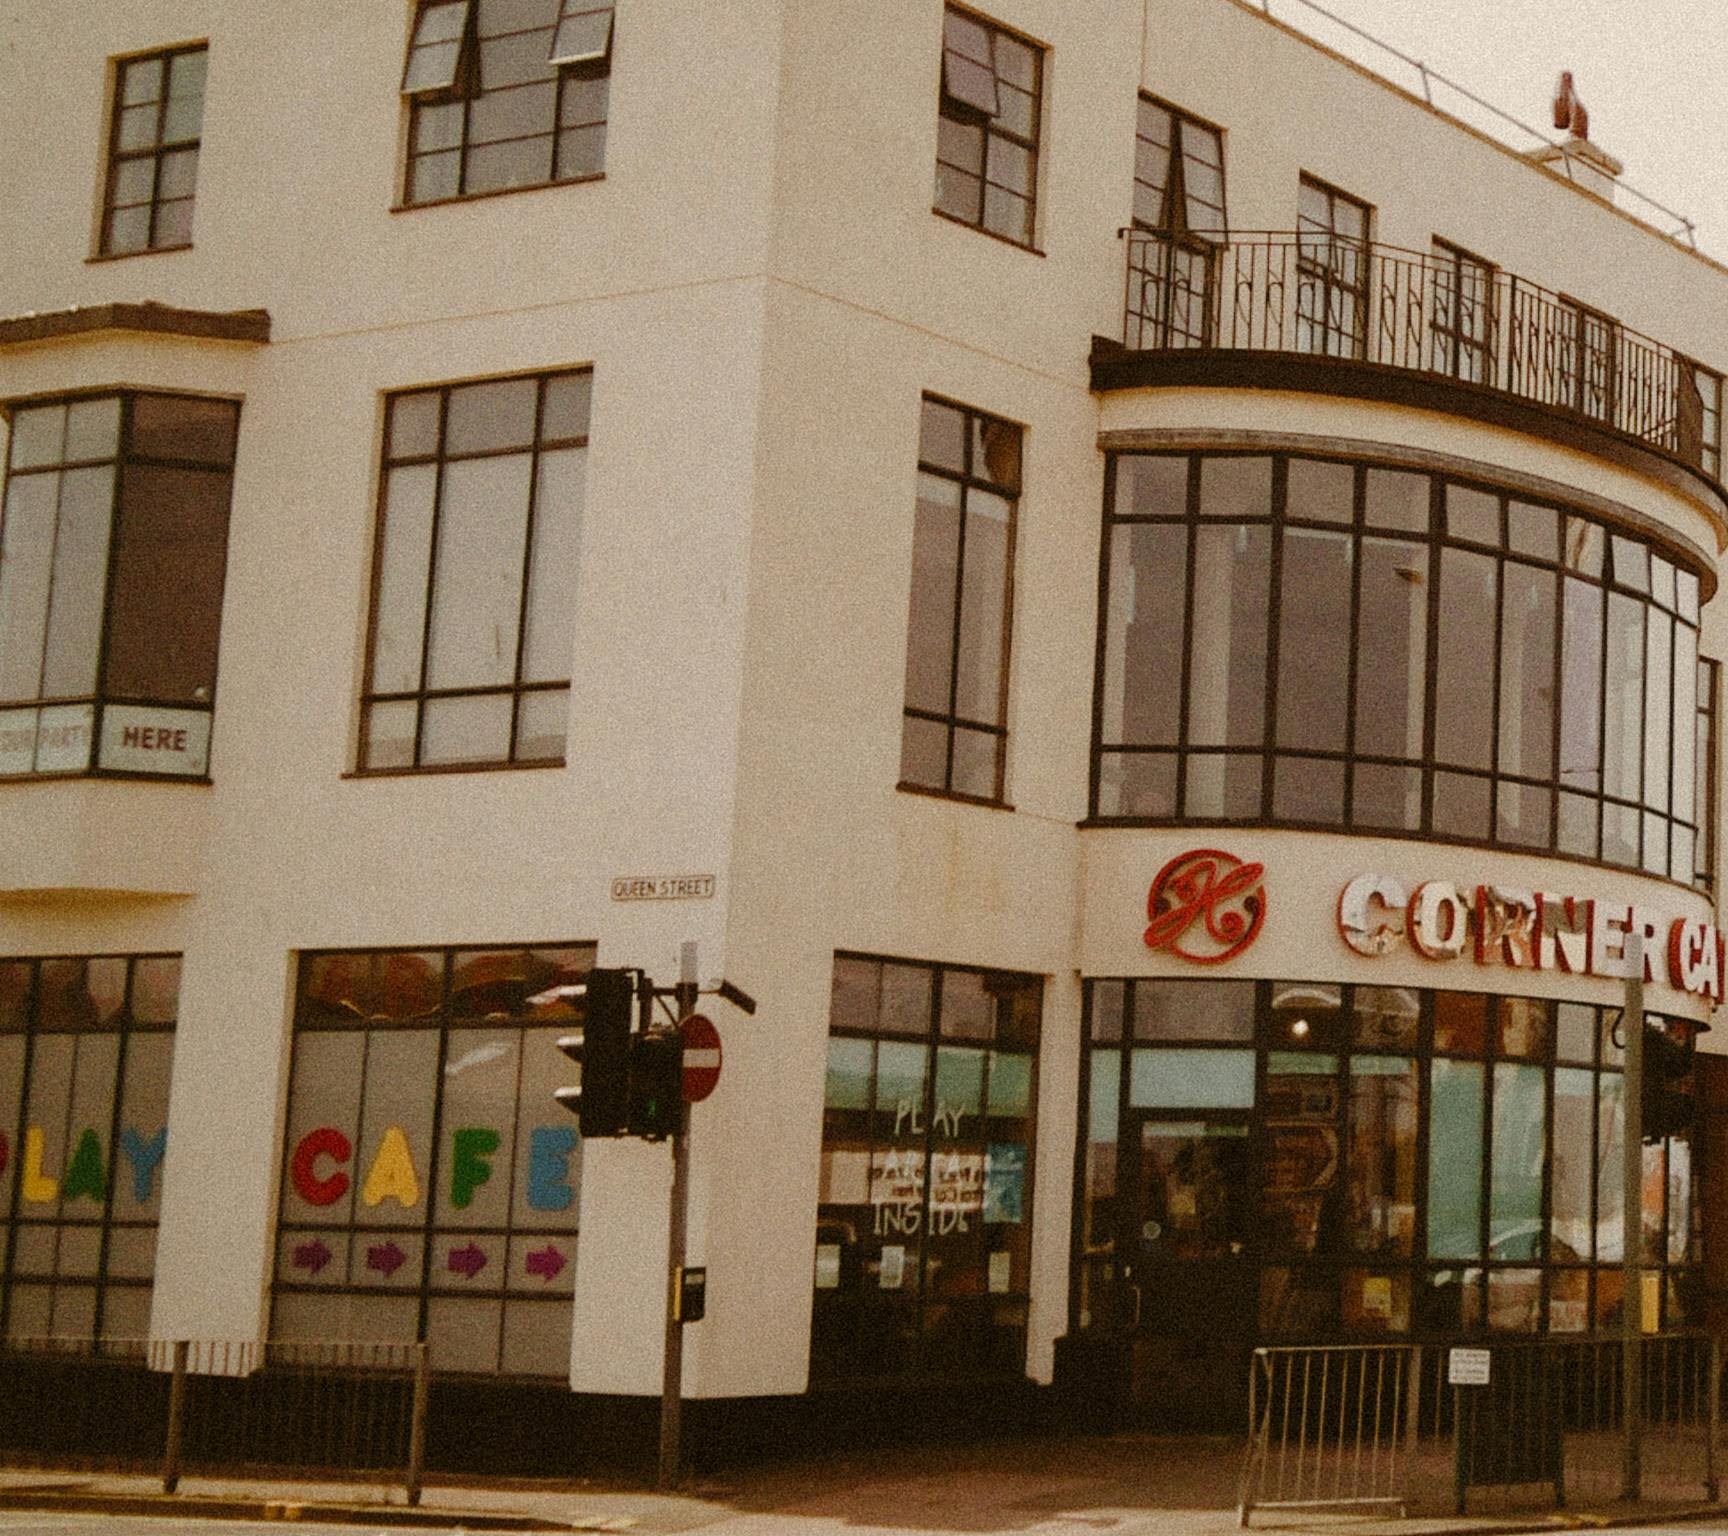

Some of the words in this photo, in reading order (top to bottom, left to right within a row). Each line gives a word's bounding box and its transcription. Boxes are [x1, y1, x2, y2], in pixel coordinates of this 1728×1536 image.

[123, 726, 188, 752] HERE
[614, 881, 656, 897] QUEEN
[660, 879, 710, 896] STREET
[1336, 871, 1668, 984] CORNER
[1668, 916, 1726, 1006] CA
[894, 1096, 967, 1138] PLAY
[0, 1126, 167, 1205] LAY
[291, 1125, 578, 1211] CAFE
[872, 1201, 969, 1236] INSIDE
